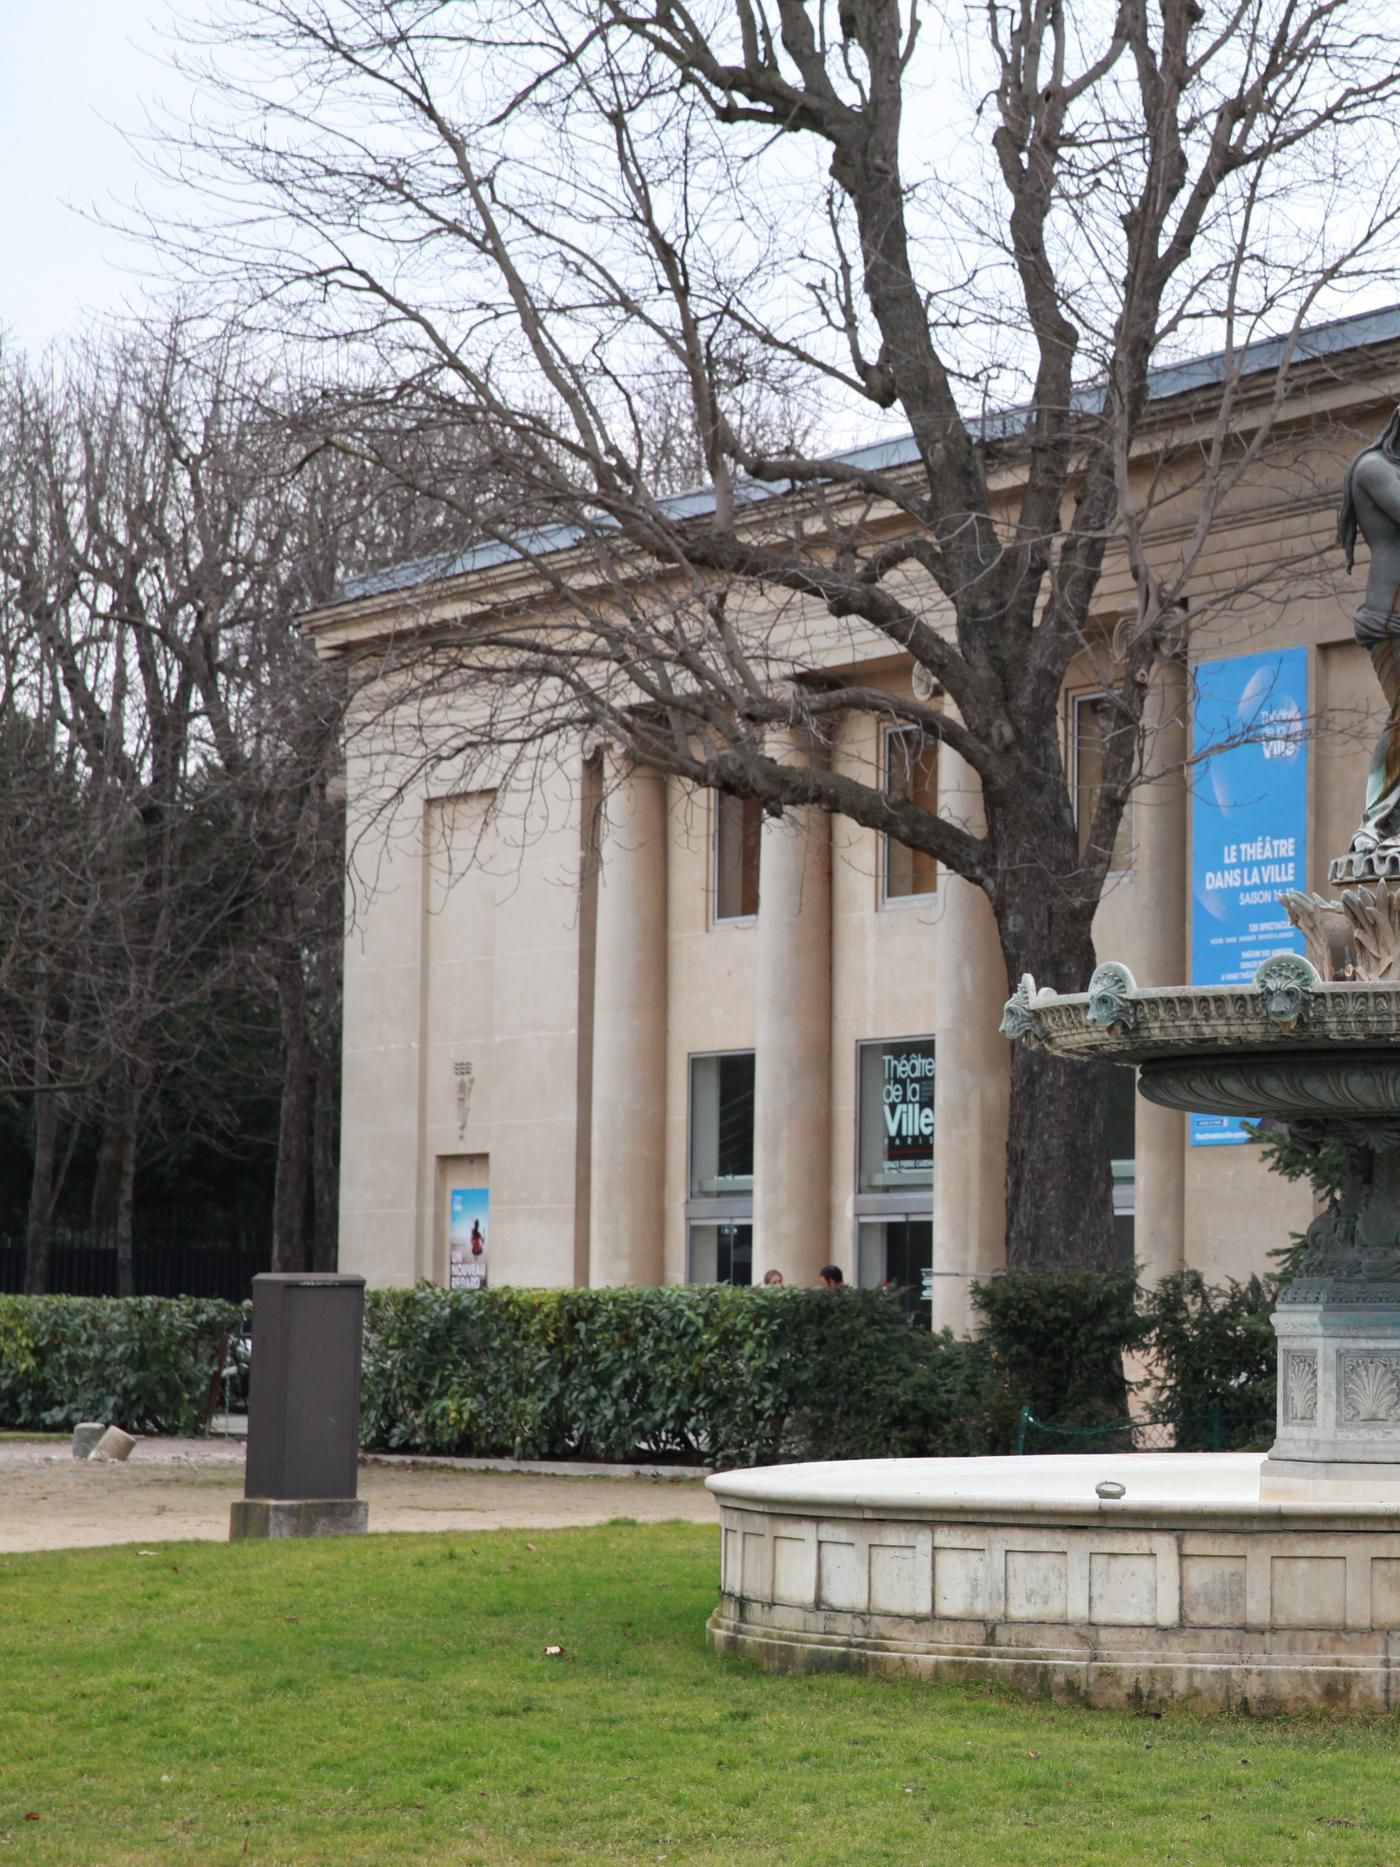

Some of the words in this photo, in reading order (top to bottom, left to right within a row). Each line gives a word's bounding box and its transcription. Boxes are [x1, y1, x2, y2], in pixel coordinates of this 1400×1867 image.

[1224, 844, 1237, 865] LE
[1240, 835, 1296, 863] THÉÂTRE
[1206, 867, 1242, 891] DANS
[1243, 866, 1260, 887] LA
[1261, 862, 1296, 884] VILLE
[1239, 889, 1272, 906] SAISON
[882, 1053, 935, 1079] Théâtre
[883, 1079, 903, 1103] de
[906, 1078, 919, 1102] la
[883, 1103, 934, 1137] Ville
